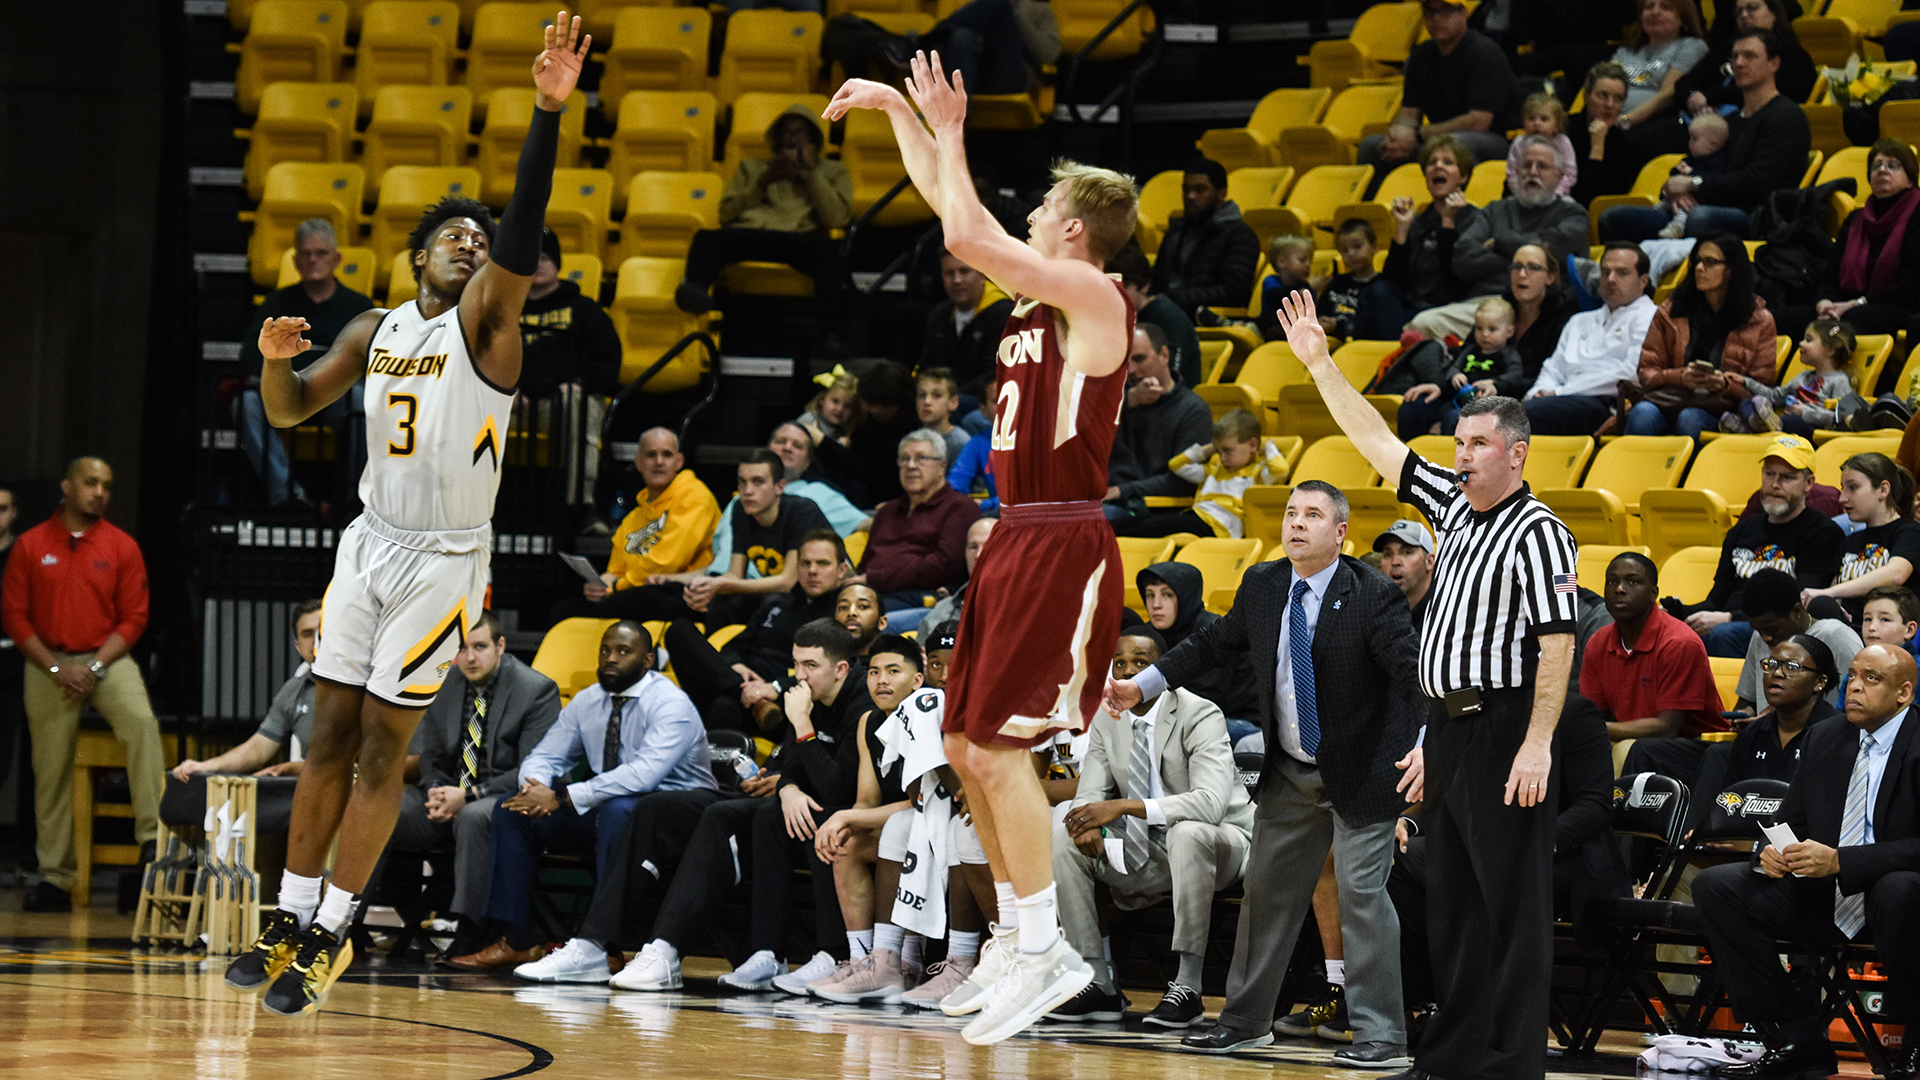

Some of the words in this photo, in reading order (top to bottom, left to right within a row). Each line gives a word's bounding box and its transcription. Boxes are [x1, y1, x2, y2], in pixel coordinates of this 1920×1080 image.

[367, 347, 449, 381] TOWSON
[996, 328, 1045, 367] ON
[387, 391, 418, 458] 3
[1741, 793, 1783, 817] TOWSO
[1867, 994, 1882, 1013] G
